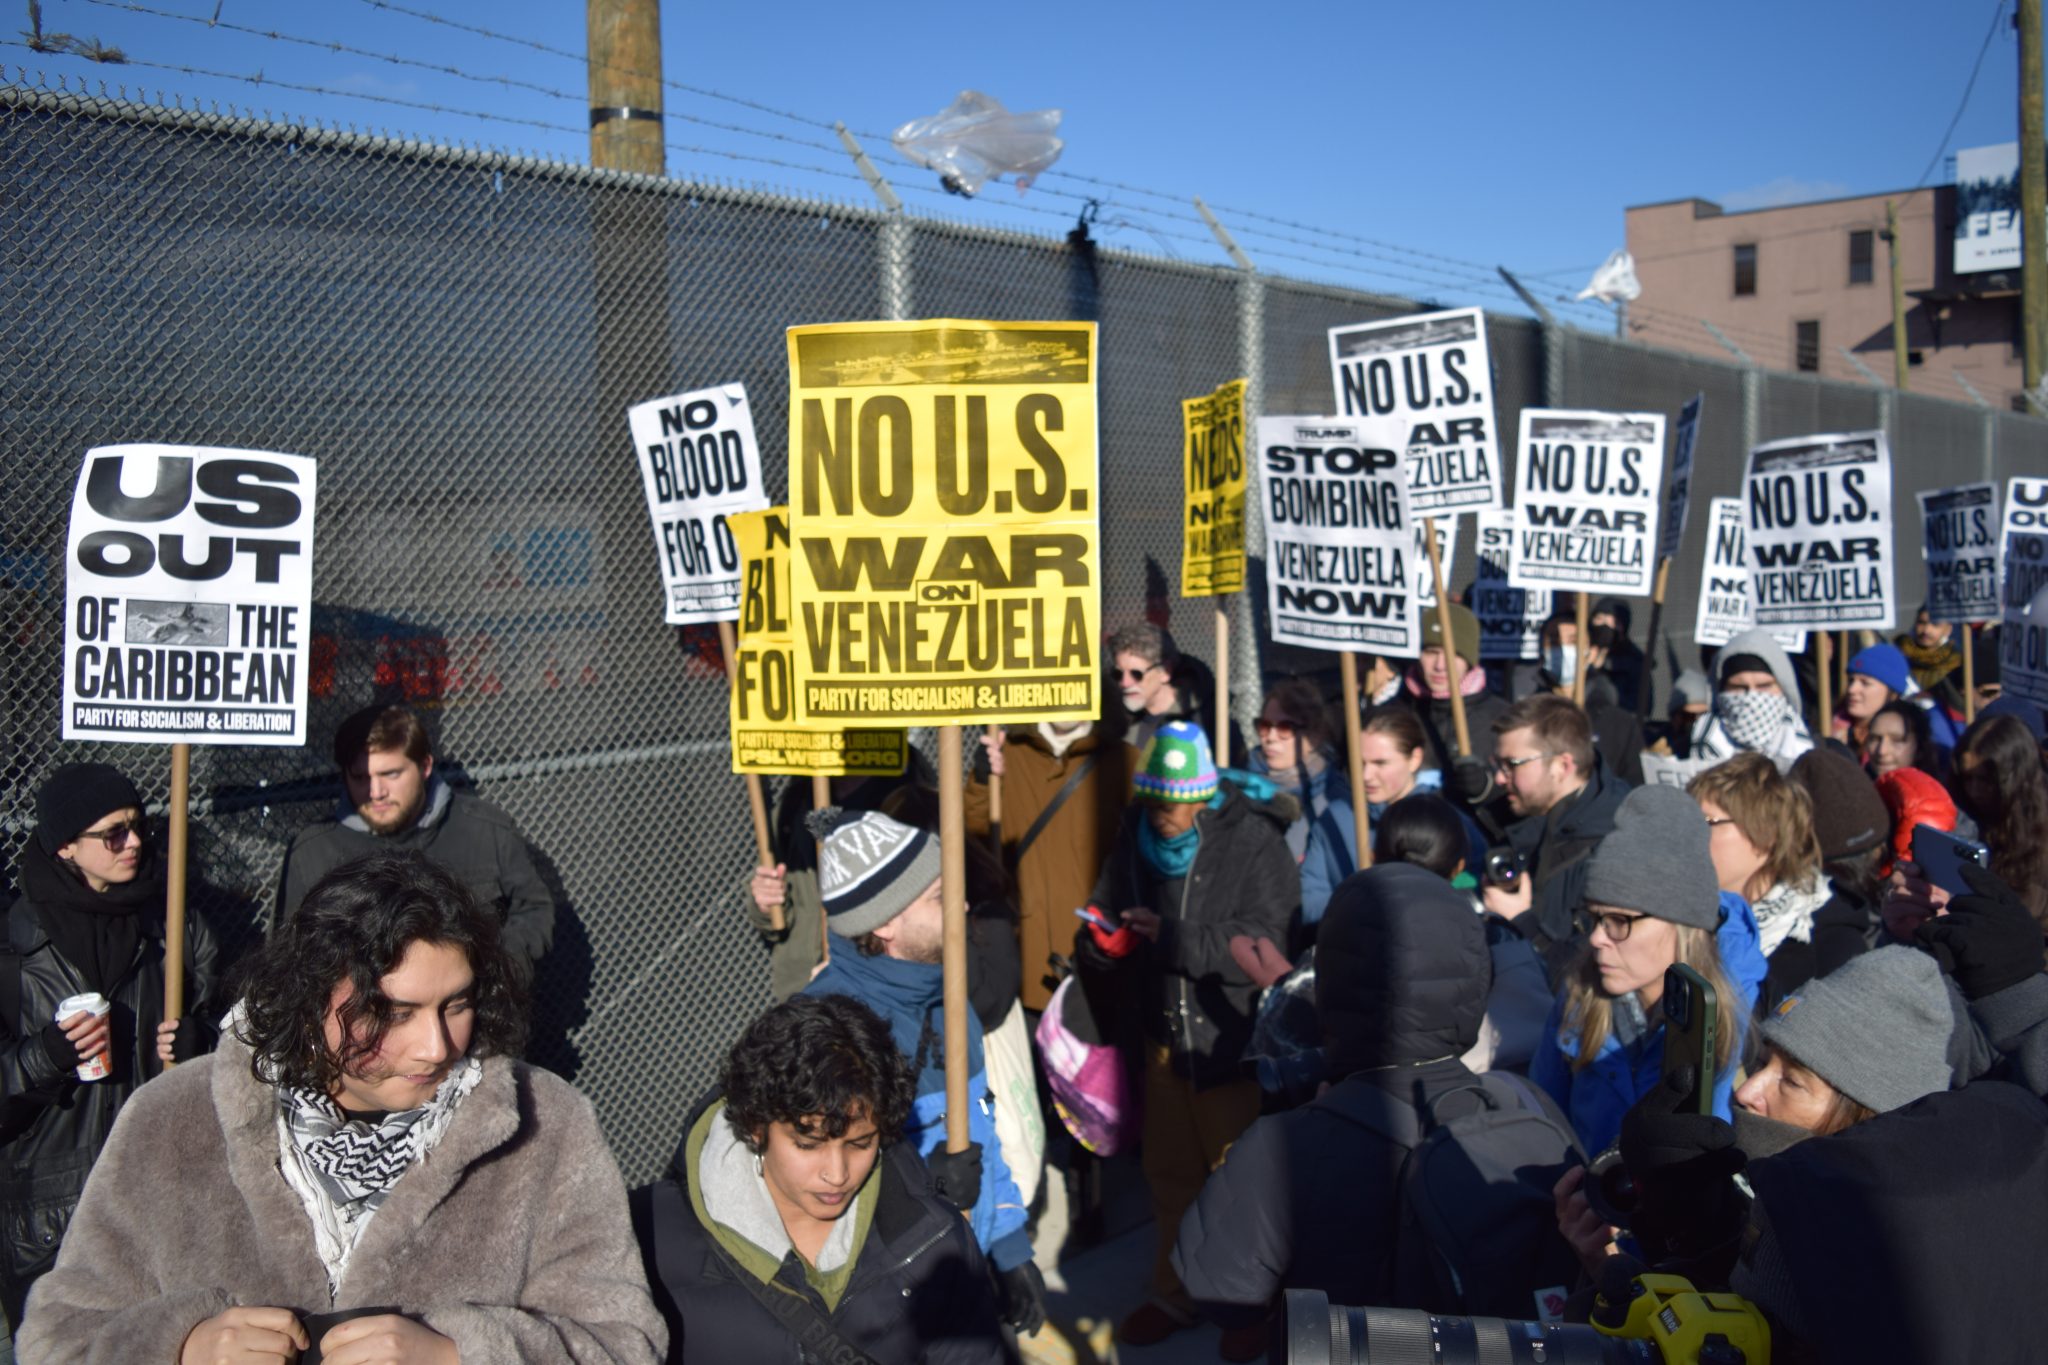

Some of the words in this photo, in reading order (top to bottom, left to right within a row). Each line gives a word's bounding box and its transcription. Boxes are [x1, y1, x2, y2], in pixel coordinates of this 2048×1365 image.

[1340, 358, 1396, 417] NO
[1401, 347, 1482, 411] U.S.
[658, 400, 718, 438] NO
[1296, 429, 1352, 439] TRUMP
[1407, 417, 1487, 446] AR
[648, 429, 748, 504] BLOOD
[801, 394, 915, 518] NO
[934, 393, 1089, 516] U.S.
[1266, 445, 1397, 476] STOP
[1405, 447, 1491, 490] ZUELA
[1526, 443, 1576, 493] NO
[1585, 445, 1649, 498] U.S.
[86, 455, 302, 529] US
[1268, 476, 1402, 530] BOMBING
[1750, 475, 1797, 530] NO
[1805, 468, 1879, 525] U.S.
[1483, 527, 1513, 545] ST
[1525, 504, 1646, 534] WAR
[1952, 508, 1994, 547] U.S.
[77, 530, 301, 584] OUT
[662, 517, 712, 578] FOR
[799, 533, 1090, 593] WAR
[1274, 539, 1407, 589] VENEZUELA
[1522, 530, 1643, 567] VENEZUELA
[1752, 537, 1880, 567] WAR
[1930, 557, 1995, 578] WAR
[921, 584, 972, 602] ON
[1276, 584, 1407, 621] NOW!
[1754, 566, 1882, 605] VENEZUELA
[76, 595, 120, 642] OF
[236, 603, 298, 649] THE
[801, 596, 1092, 674] VENEZUELA
[74, 645, 296, 704] CARIBBEAN
[737, 650, 795, 722] FO
[808, 686, 858, 711] PARTY
[859, 687, 890, 711] FOR
[891, 685, 975, 710] SOCIALISM
[976, 686, 998, 708] &
[1000, 681, 1087, 708] LIBERATION
[76, 707, 115, 726] PARTY
[116, 709, 139, 728] FOR
[140, 710, 205, 730] SOCIALISM
[206, 712, 222, 729] &
[224, 712, 292, 732] LIBERATION
[739, 731, 767, 748] PARTY
[768, 732, 785, 749] FOR
[786, 732, 830, 750] SOCIALISM
[831, 733, 844, 750] &
